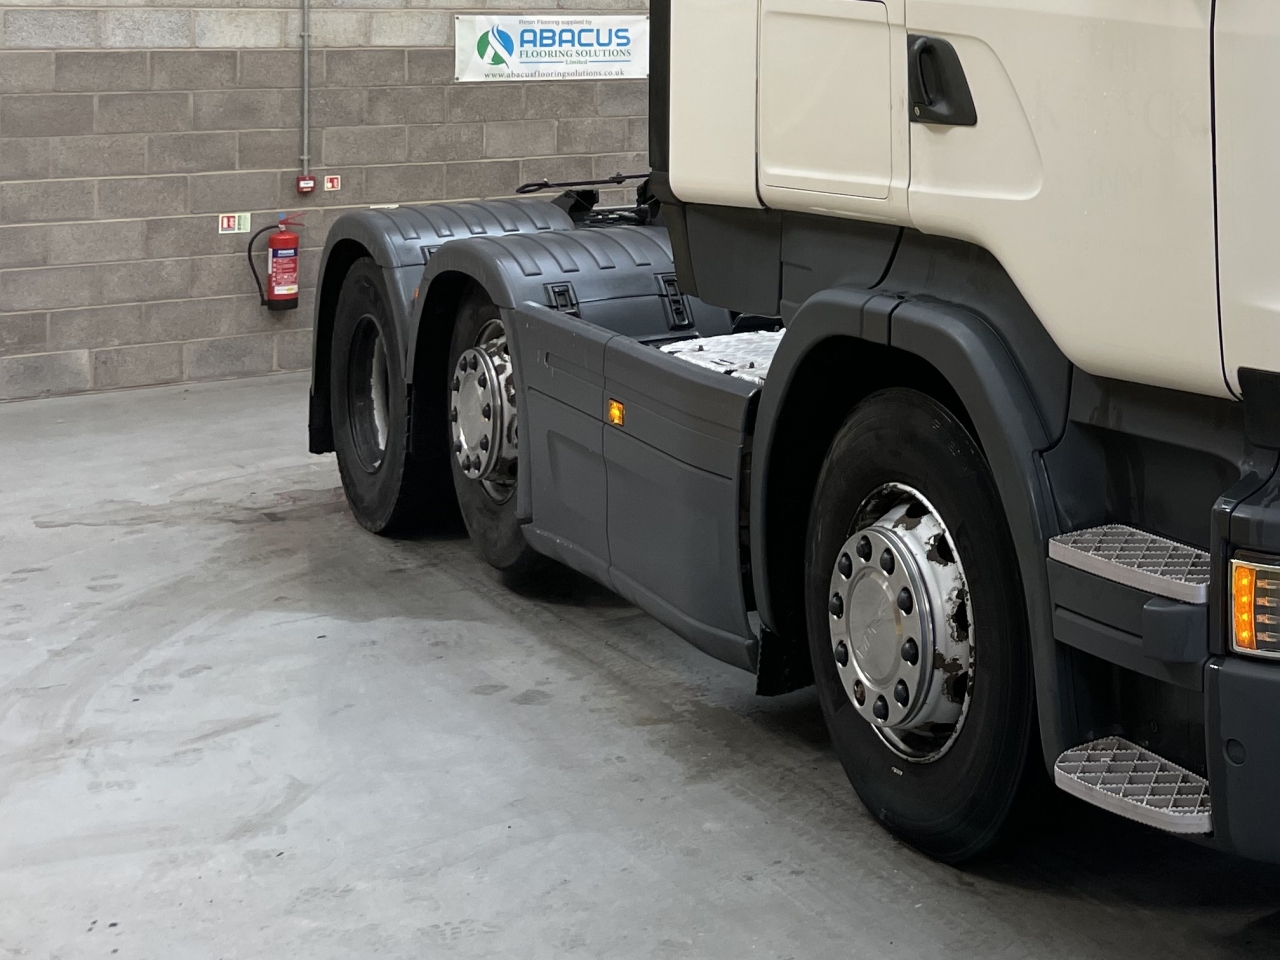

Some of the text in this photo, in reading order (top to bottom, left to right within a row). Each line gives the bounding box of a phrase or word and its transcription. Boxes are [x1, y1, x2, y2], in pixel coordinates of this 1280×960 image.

[519, 28, 631, 48] ABACUS
[519, 49, 632, 58] FLOORING SOLUTIONS
[484, 68, 625, 80] www.abacusflooringsolutions.co.uk
